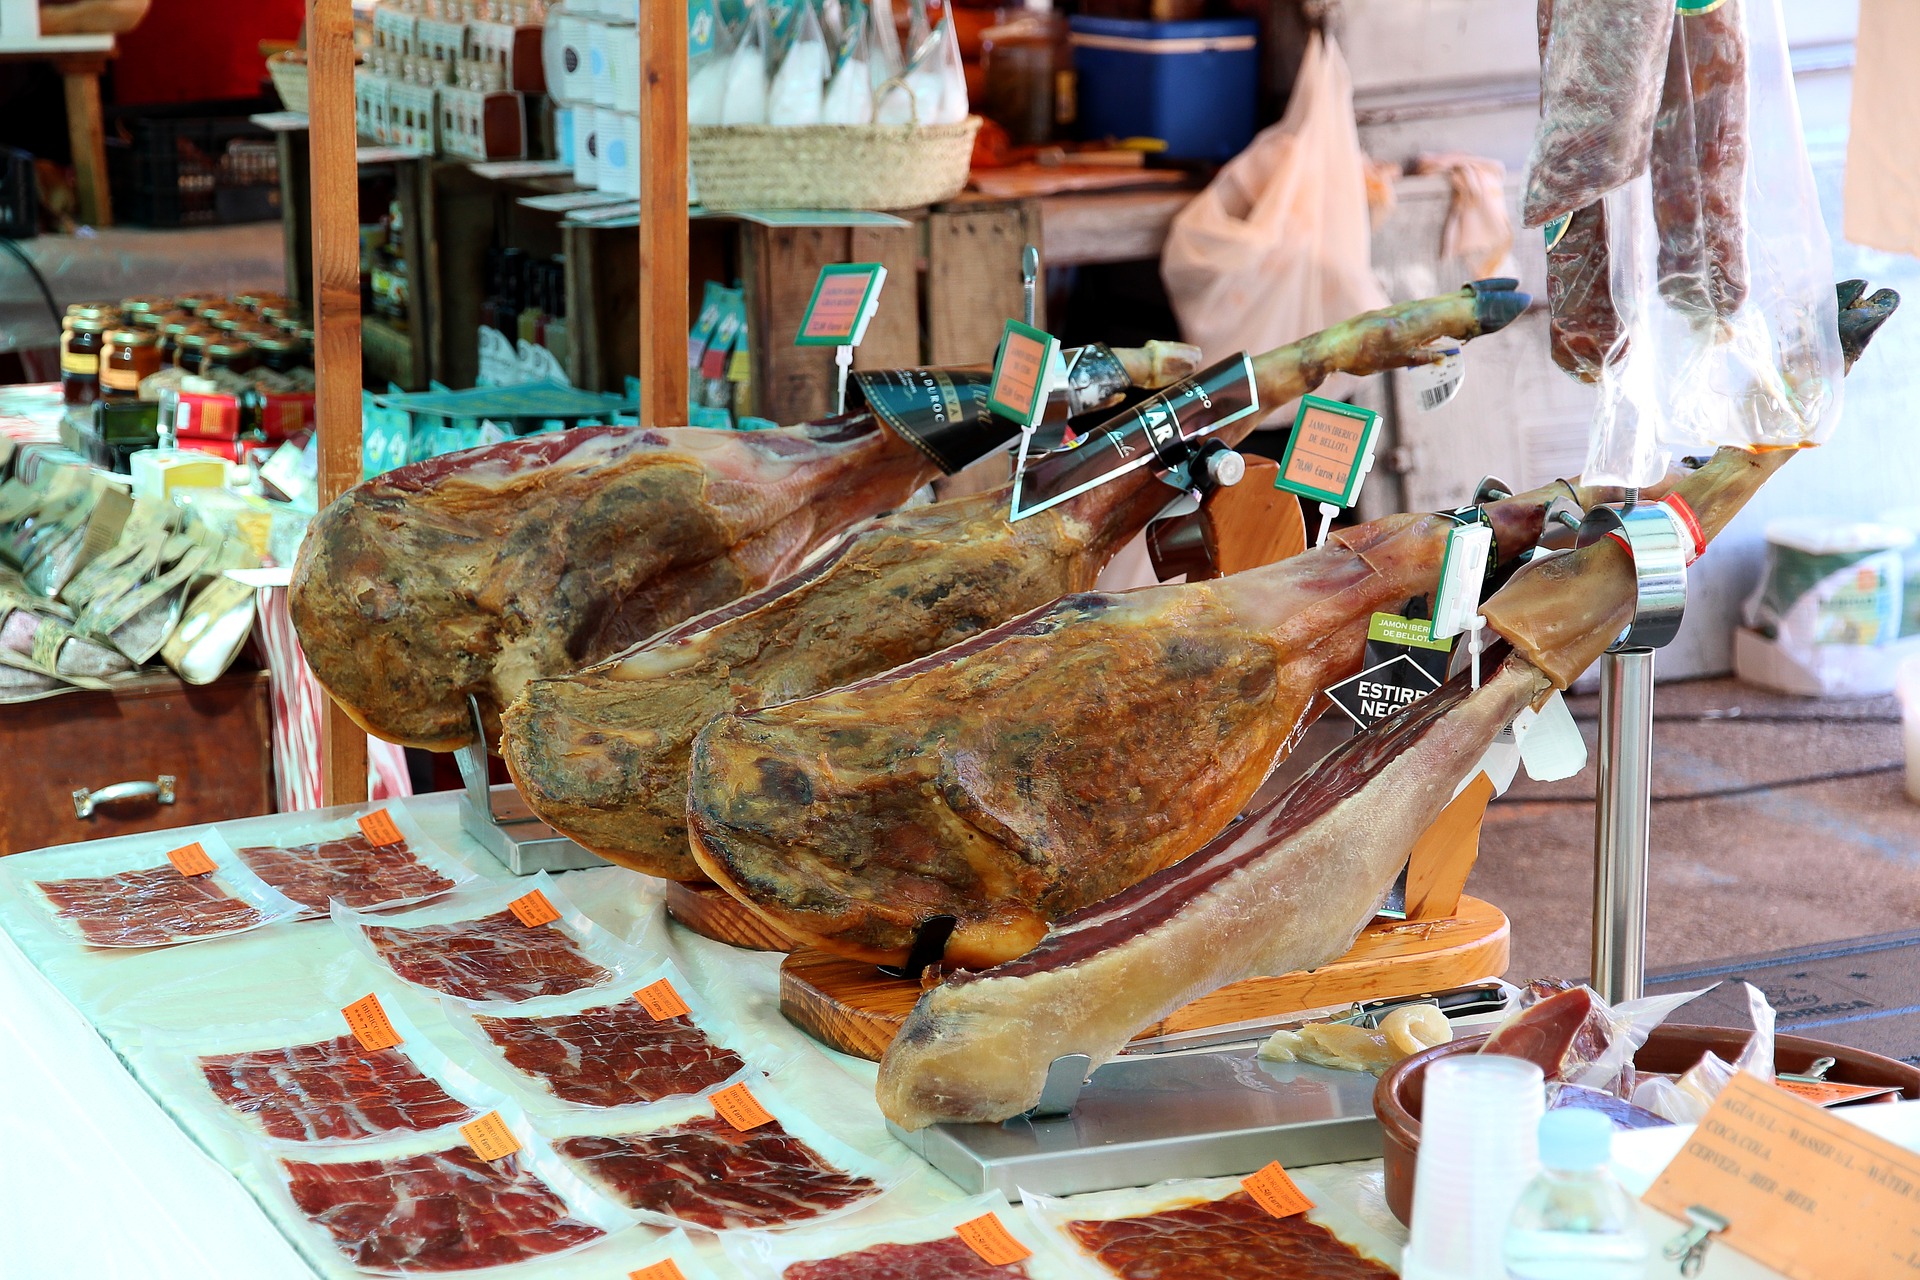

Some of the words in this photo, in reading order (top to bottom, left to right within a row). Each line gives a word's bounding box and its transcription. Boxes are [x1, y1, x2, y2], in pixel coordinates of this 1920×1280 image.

[923, 378, 945, 423] DUROC
[1308, 433, 1318, 444] DE
[1319, 437, 1349, 454] BELLOTA
[1331, 425, 1359, 441] IBERICO
[1383, 629, 1395, 637] DE
[1360, 699, 1406, 718] NEG
[360, 1002, 380, 1031] IBERICO
[1260, 1169, 1284, 1195] CHORIZO
